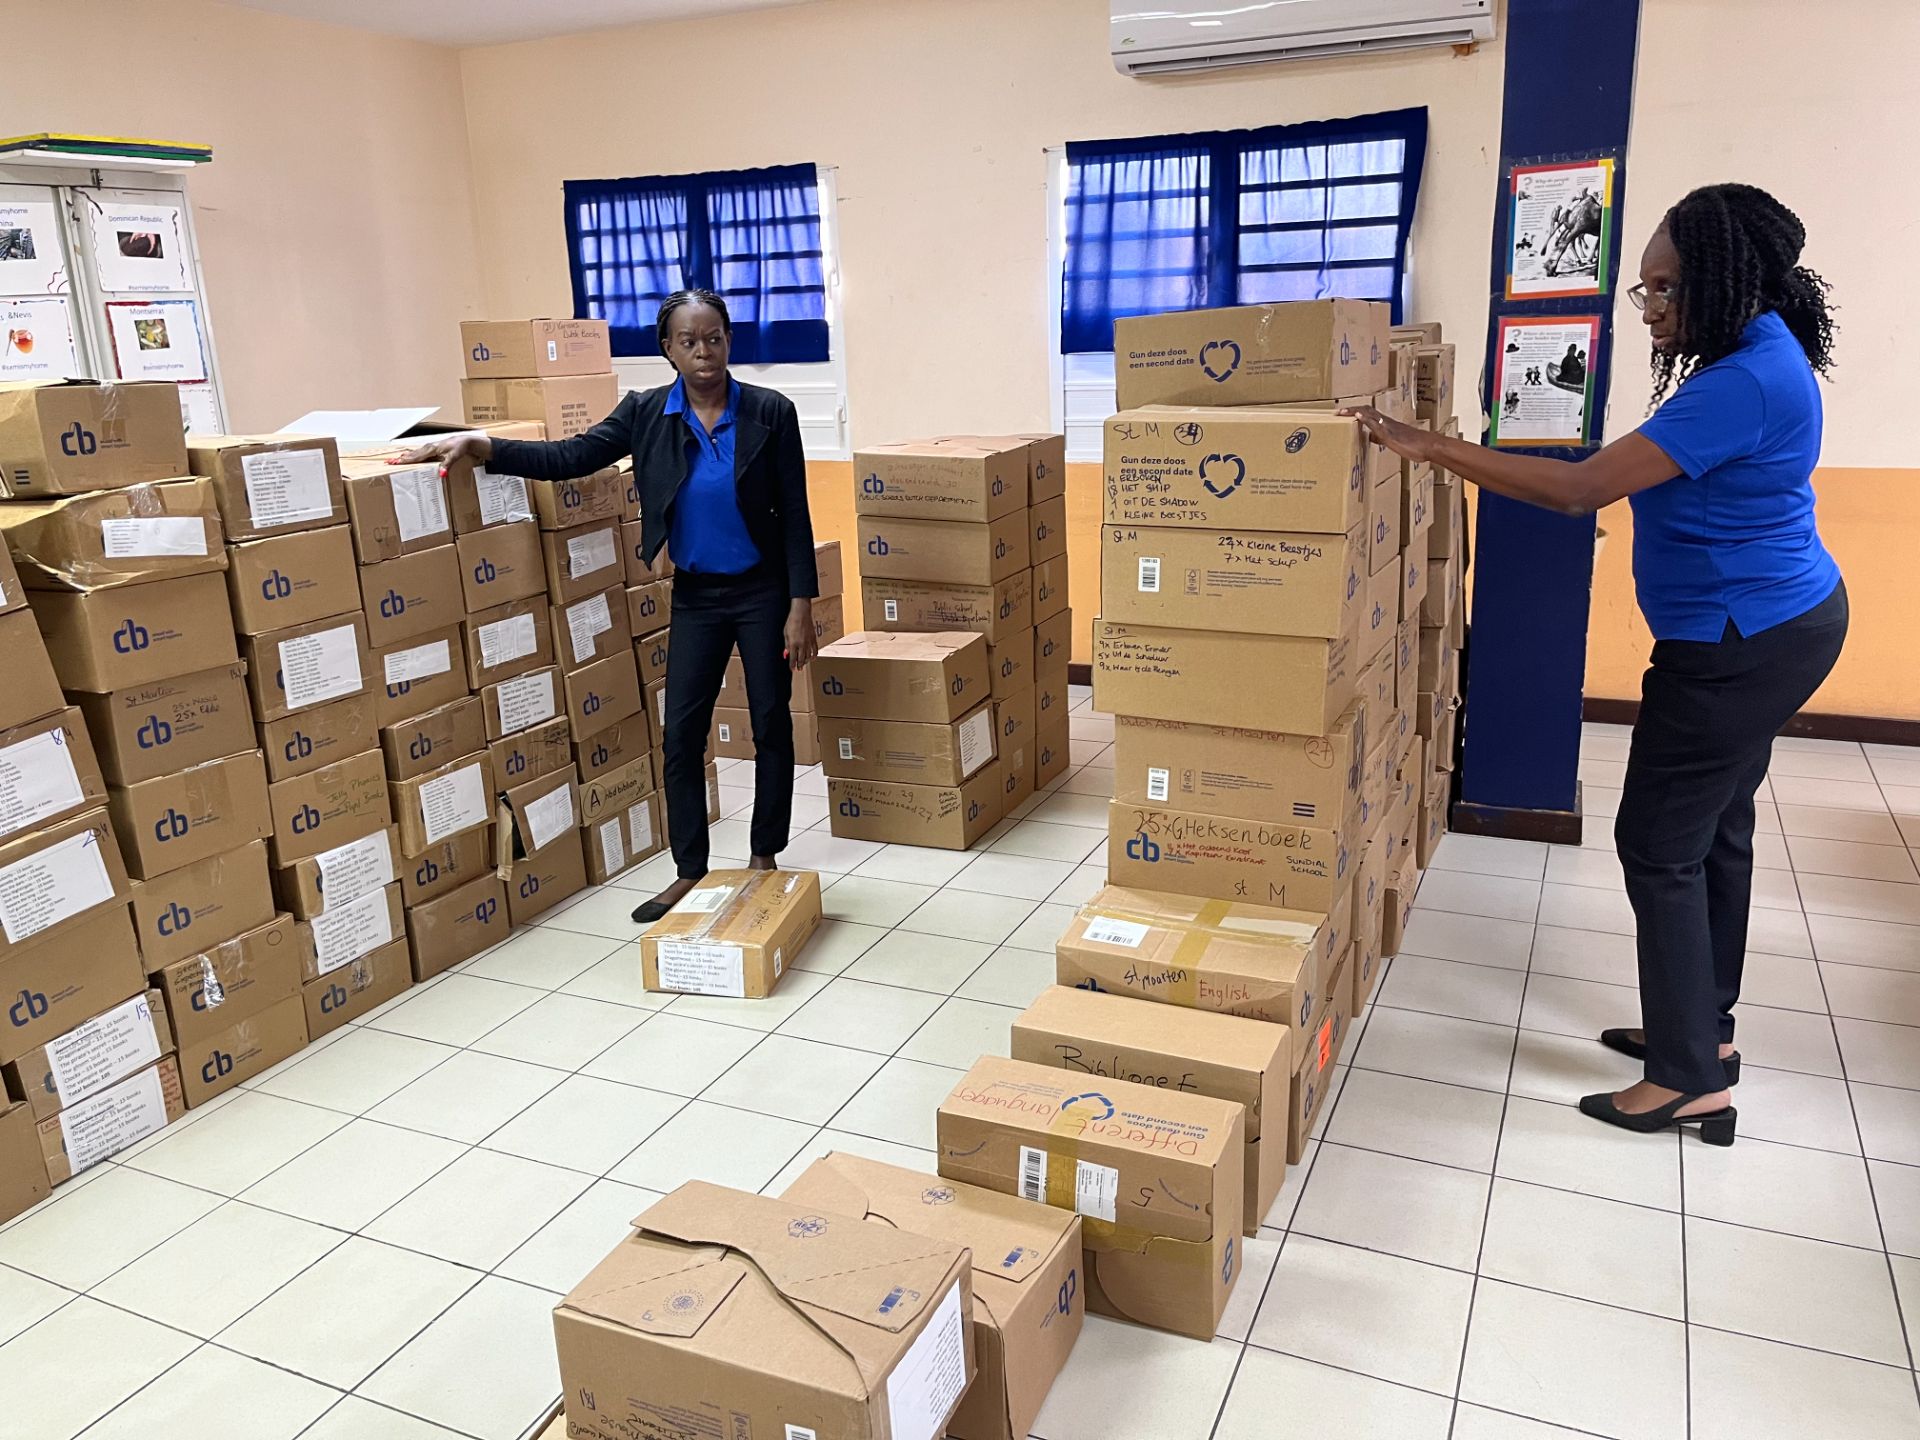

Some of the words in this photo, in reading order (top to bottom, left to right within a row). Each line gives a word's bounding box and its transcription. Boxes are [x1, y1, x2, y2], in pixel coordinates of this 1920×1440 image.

[108, 215, 139, 223] Dominican
[140, 215, 164, 223] Republic
[129, 308, 165, 316] Montserrat
[472, 342, 490, 362] cb
[1129, 351, 1146, 359] Gun
[1147, 349, 1166, 358] deze
[1167, 348, 1188, 356] doos
[1146, 358, 1175, 367] second
[1176, 357, 1195, 366] date
[61, 422, 96, 456] cb
[1121, 456, 1139, 465] Gun
[1141, 456, 1162, 465] deze
[1163, 457, 1186, 465] doos
[1139, 467, 1171, 476] second
[1173, 467, 1194, 476] date
[863, 473, 885, 495] cb
[1141, 497, 1156, 507] DE
[867, 535, 890, 556] cb
[474, 557, 496, 584] cb
[262, 569, 292, 601] cb
[380, 589, 405, 618] cb
[113, 618, 149, 654] cb
[822, 675, 843, 696] cb
[583, 692, 600, 716] cb
[137, 715, 172, 749] cb
[285, 731, 313, 762] cb
[410, 732, 432, 760] cb
[591, 744, 608, 768] cb
[291, 804, 320, 834] cb
[840, 798, 860, 817] cb
[155, 808, 188, 842] cb
[1127, 832, 1160, 862] cb
[416, 859, 439, 886] cb
[1286, 856, 1328, 869] SUNDIAL
[520, 873, 540, 899] cb
[157, 902, 191, 936] cb
[475, 897, 496, 924] cb
[320, 984, 347, 1014] cb
[1199, 979, 1250, 1007] English
[9, 990, 48, 1027] cb
[202, 1050, 233, 1083] cb
[1121, 1111, 1145, 1121] date
[1127, 1119, 1153, 1130] doos
[1146, 1117, 1186, 1130] second
[1064, 1117, 1198, 1156] Different
[1155, 1124, 1181, 1135] deze
[1183, 1129, 1205, 1140] Gun
[1187, 1124, 1209, 1133] een
